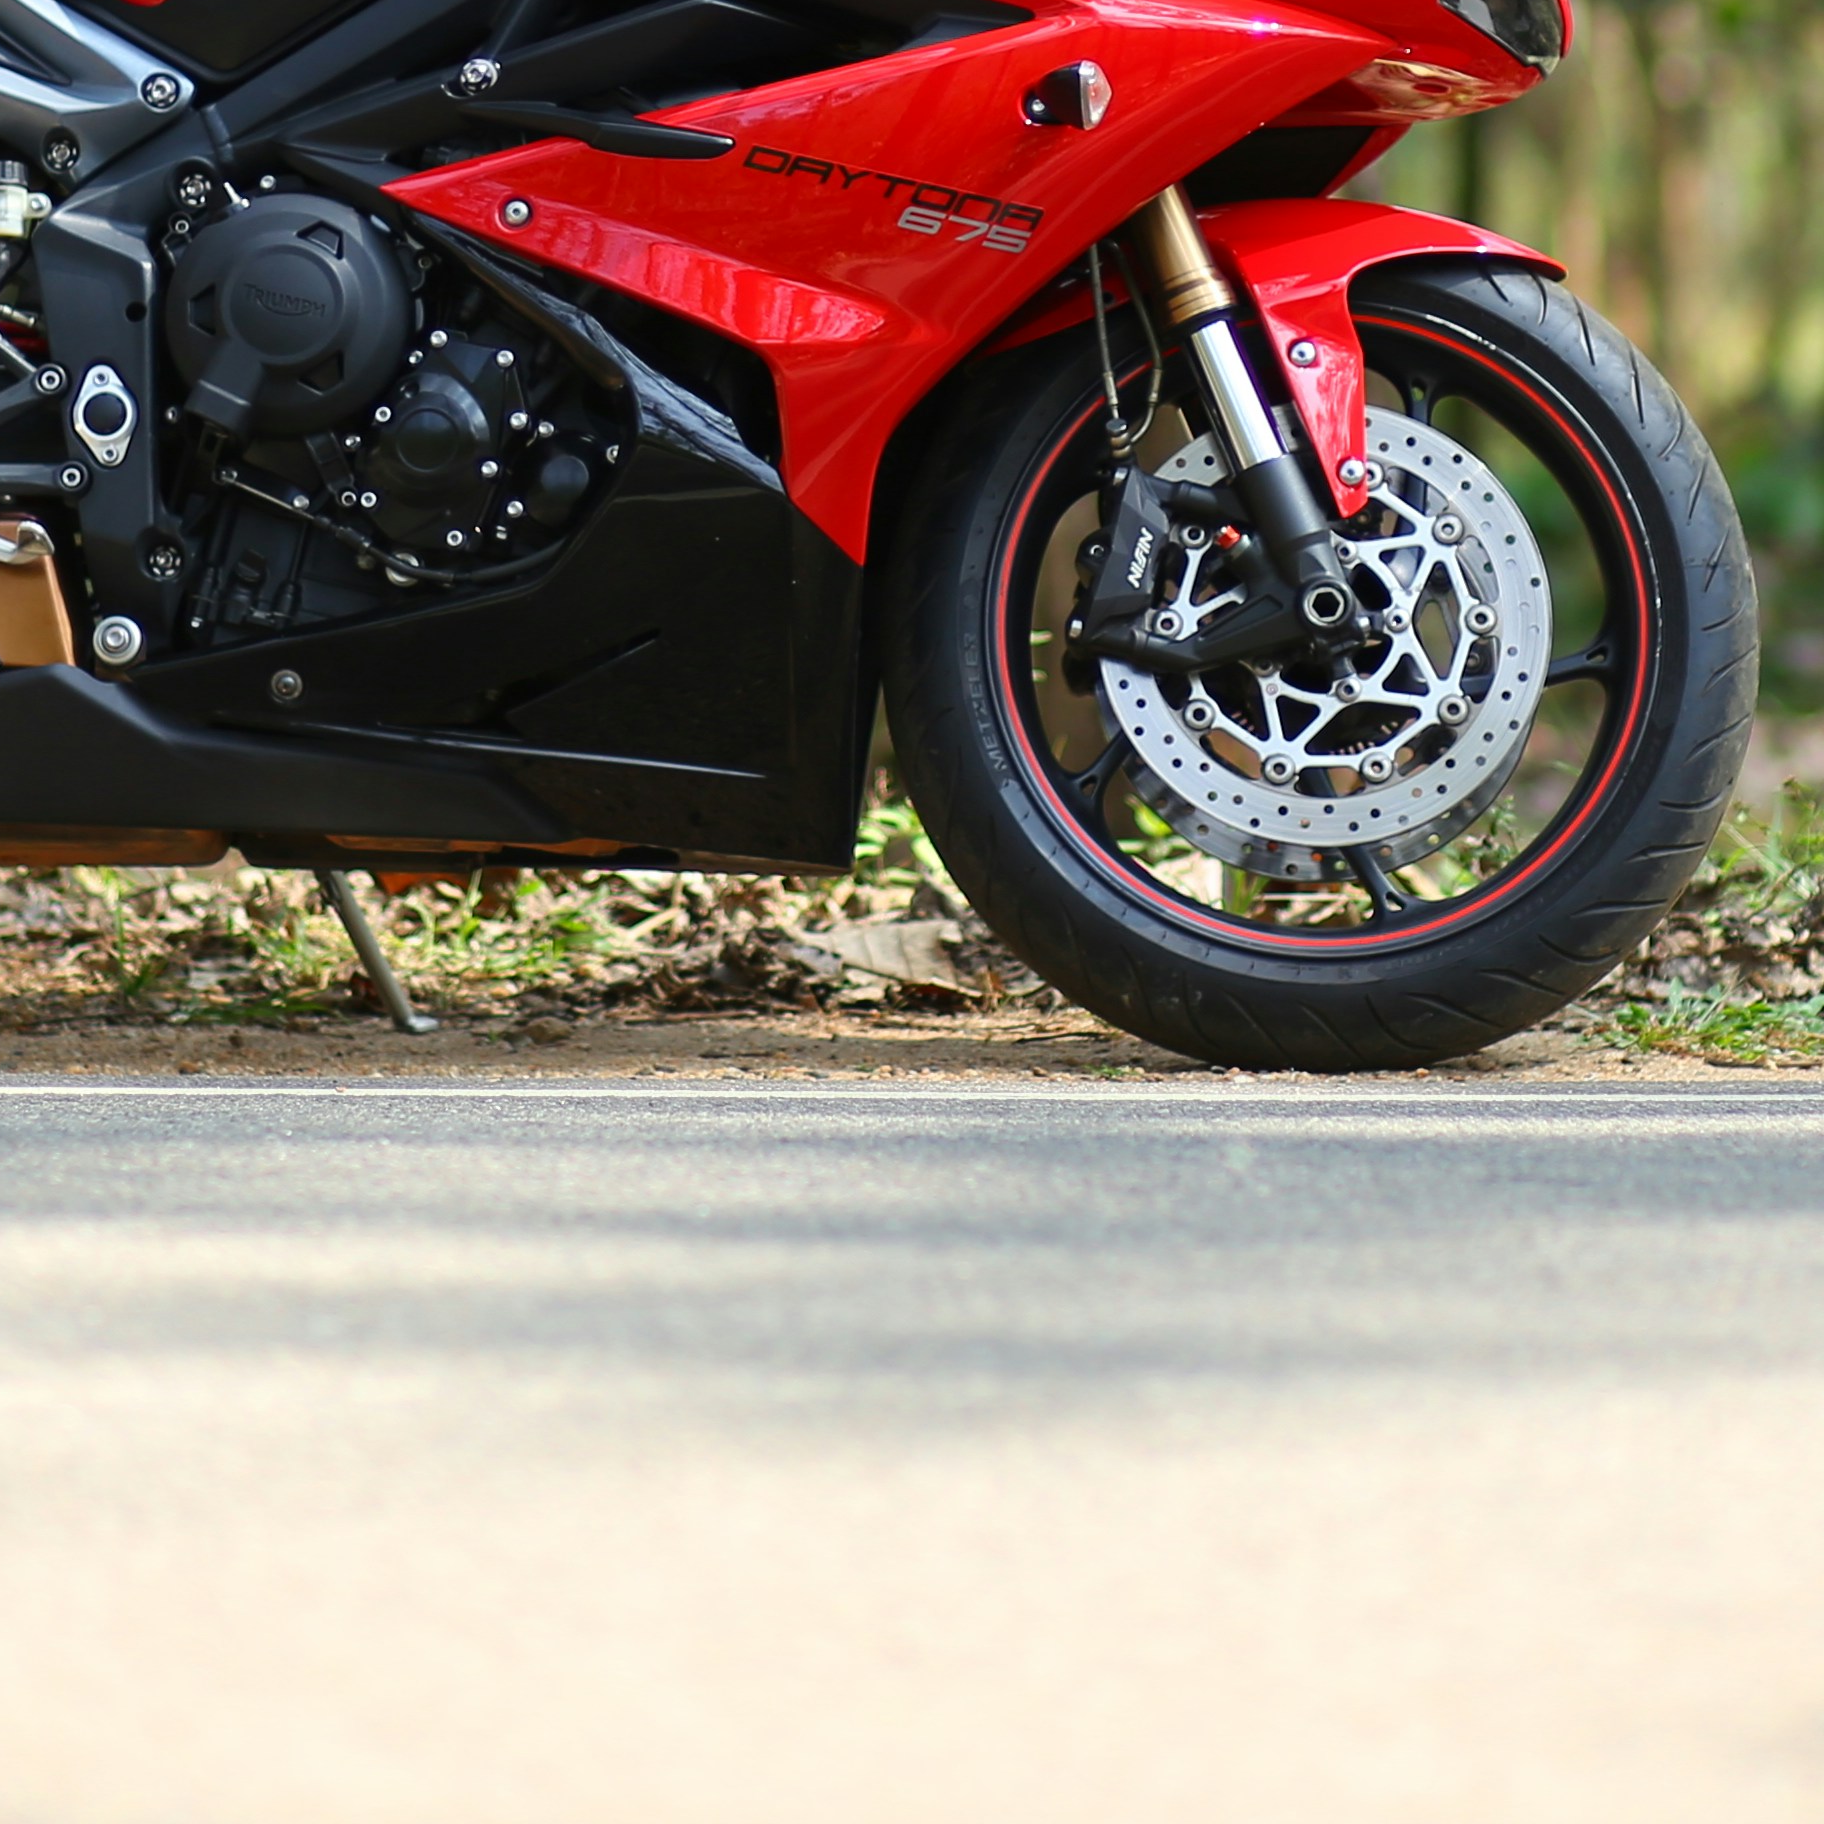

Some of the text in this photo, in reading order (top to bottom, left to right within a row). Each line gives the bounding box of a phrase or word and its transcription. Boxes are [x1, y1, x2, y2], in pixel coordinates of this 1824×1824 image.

[743, 146, 1045, 230] DAYTONA
[897, 207, 1032, 254] 675
[245, 283, 326, 317] TRIUMPH
[963, 631, 1007, 771] METZELER
